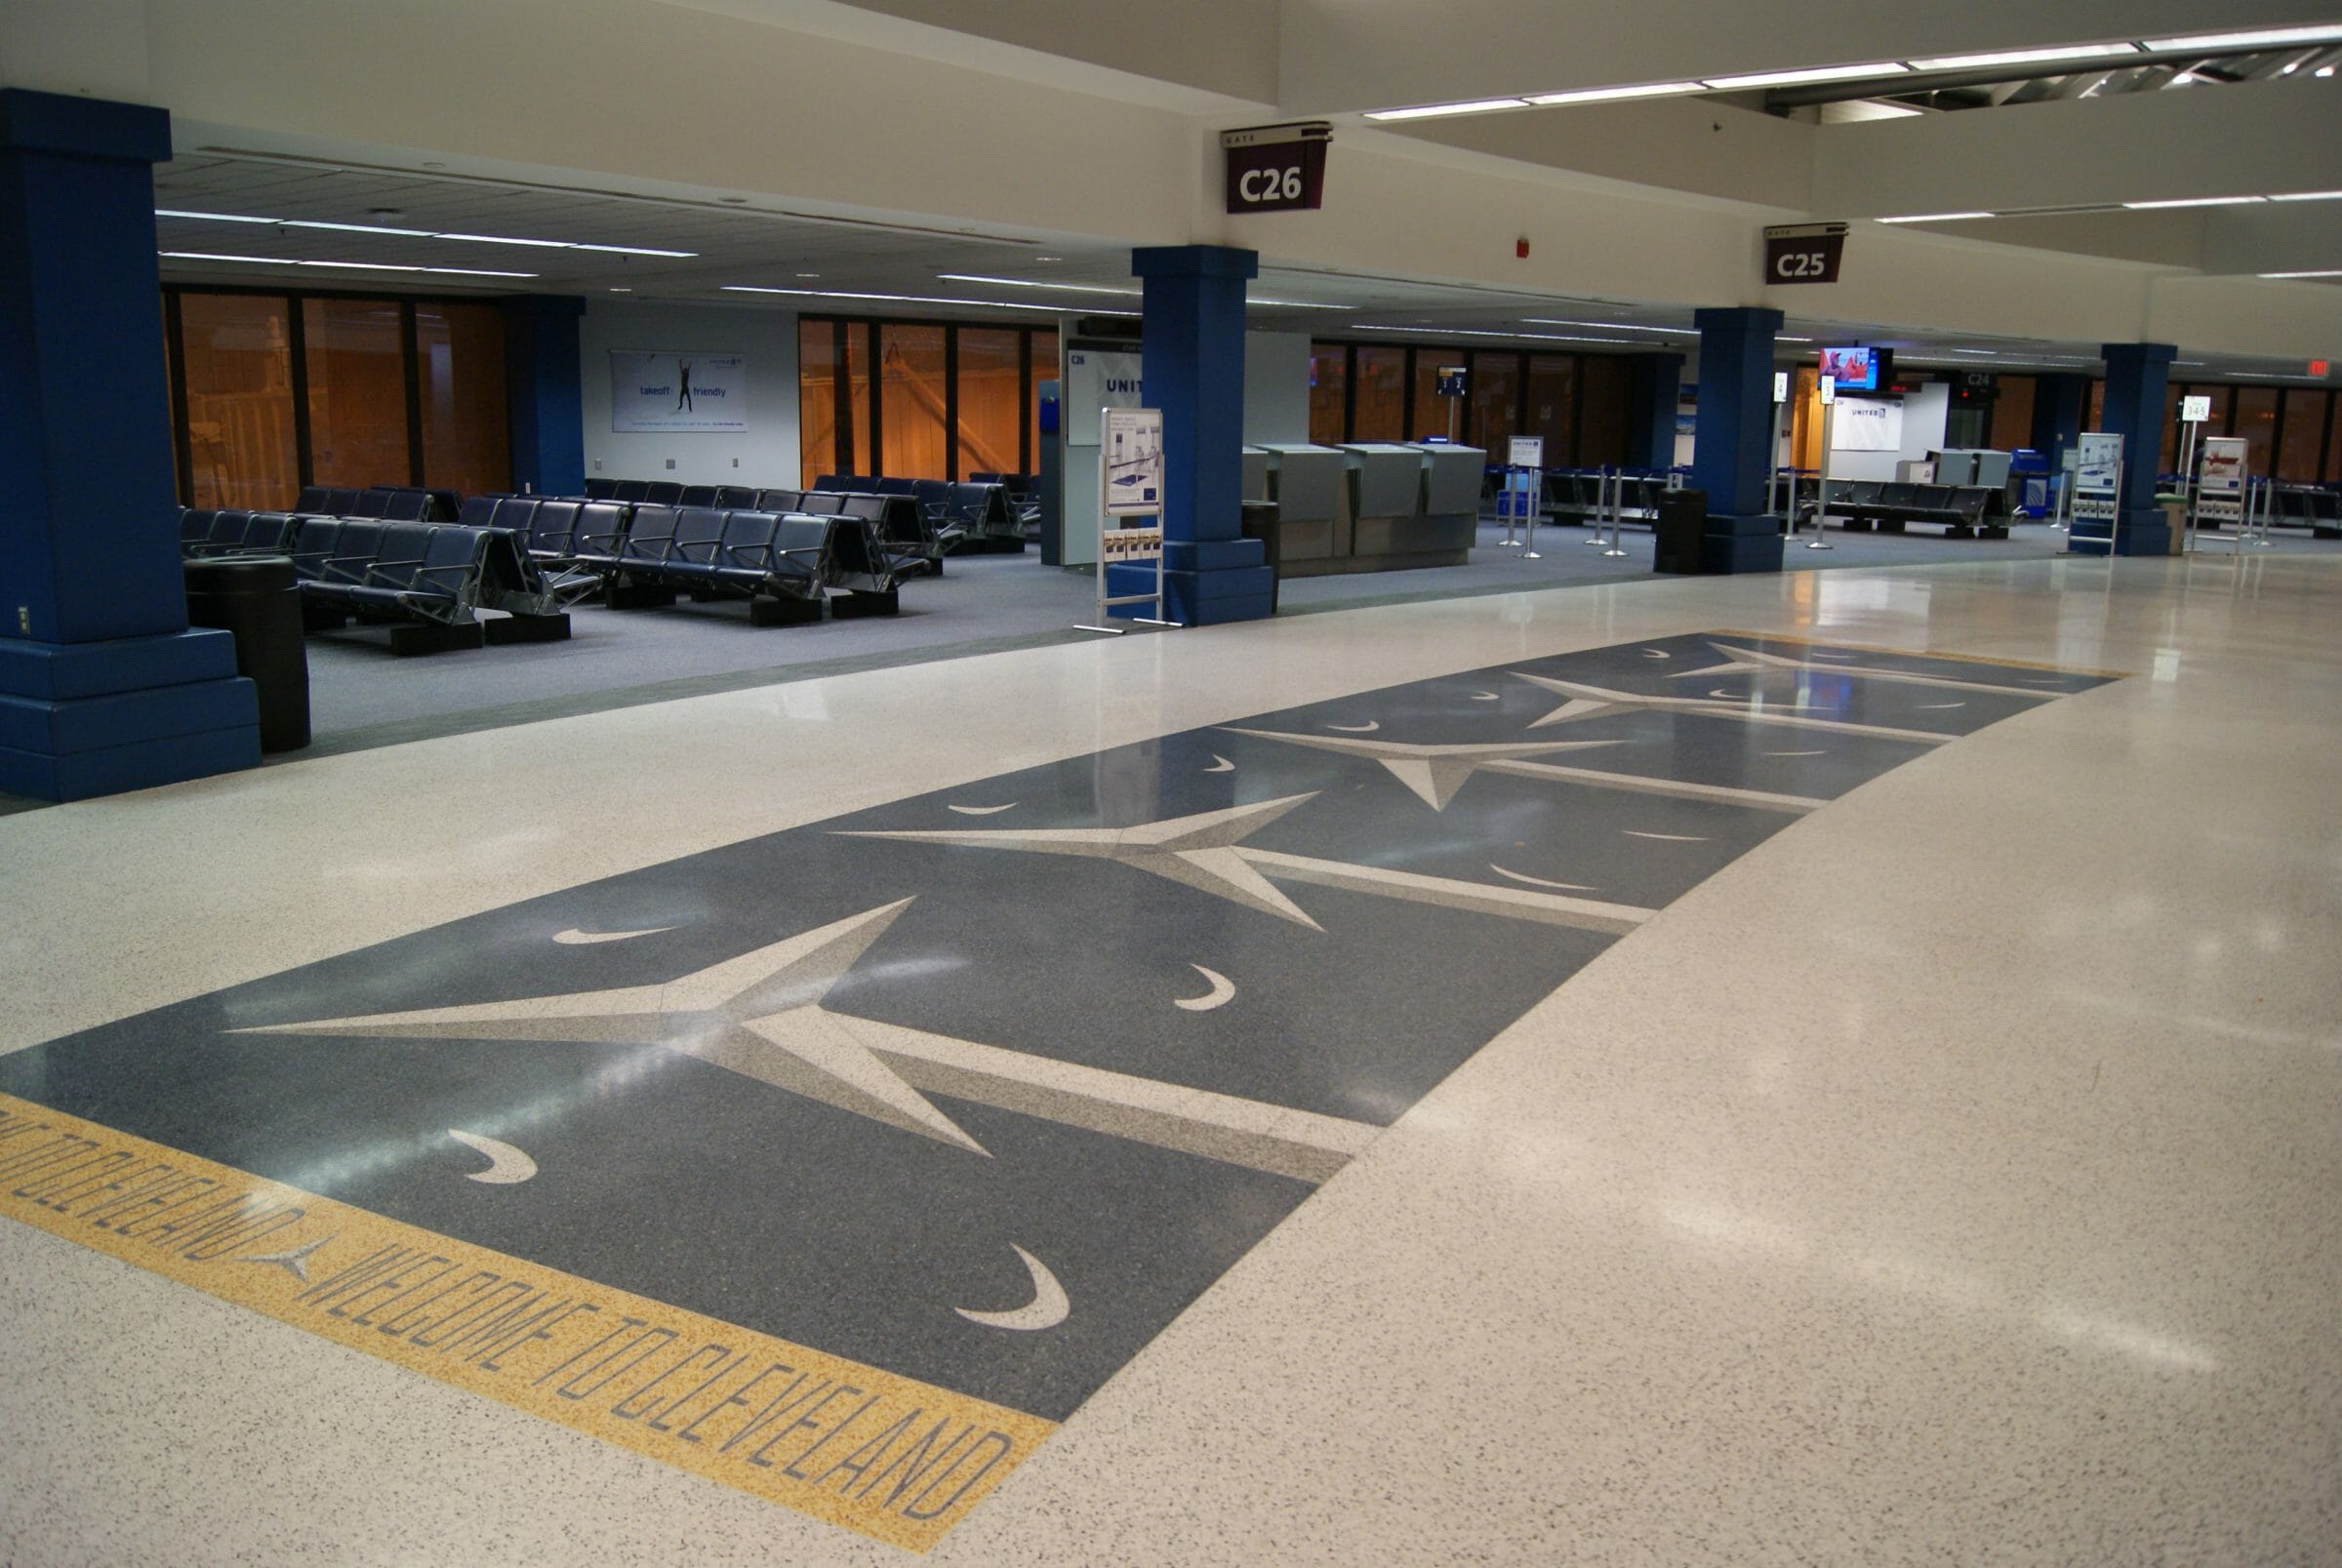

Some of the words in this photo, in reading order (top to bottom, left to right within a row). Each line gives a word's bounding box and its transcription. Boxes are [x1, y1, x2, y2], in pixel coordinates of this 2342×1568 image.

[1226, 135, 1254, 143] GATE
[1239, 166, 1302, 202] C26
[1776, 253, 1825, 277] C25
[1070, 354, 1085, 365] C26
[1107, 379, 1143, 392] UNIT
[1967, 374, 1989, 386] C24
[639, 386, 670, 396] takeoff
[693, 386, 726, 397] friendly
[11, 1150, 305, 1261] CLEVELAND
[297, 1242, 598, 1371] WELCOME
[531, 1316, 680, 1401] TO
[610, 1343, 1014, 1522] CLEVELAND
